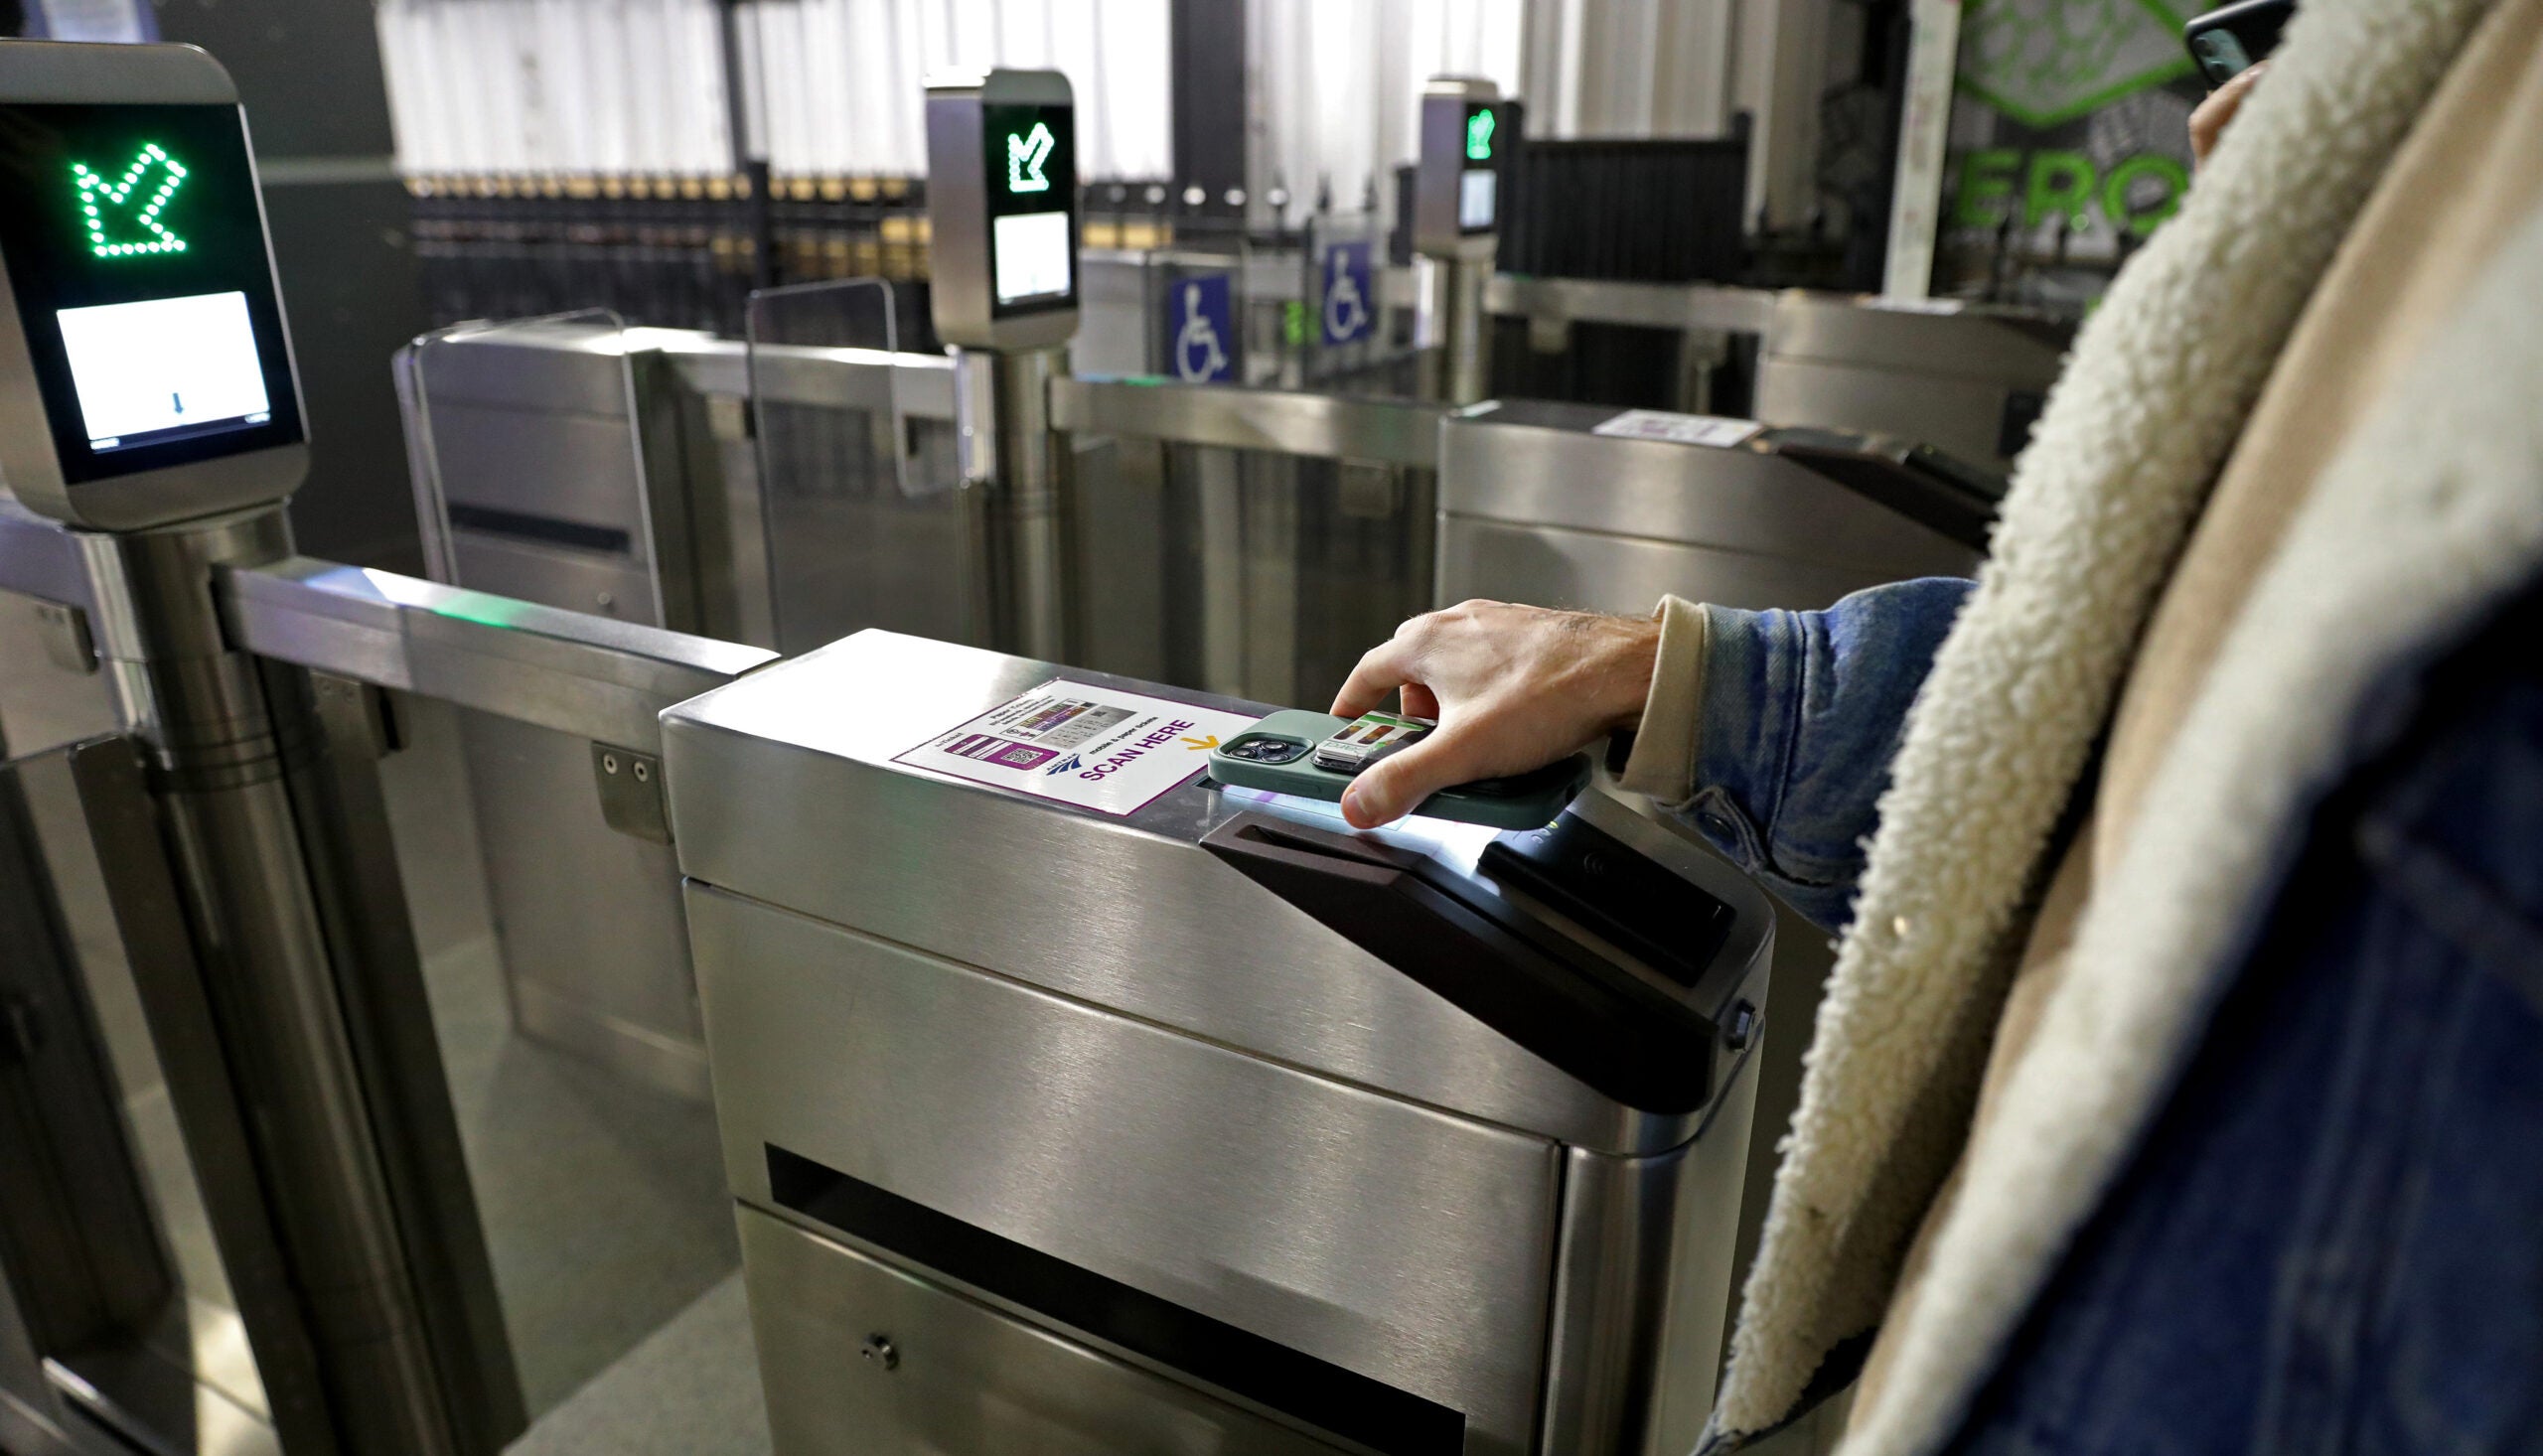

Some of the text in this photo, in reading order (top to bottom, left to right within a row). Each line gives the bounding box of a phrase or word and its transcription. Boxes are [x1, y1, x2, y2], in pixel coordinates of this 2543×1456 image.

[1080, 749, 1144, 781] SCAN
[1134, 720, 1195, 749] HERE
[1090, 742, 1113, 754] mobile
[1118, 728, 1136, 739] paper
[1135, 716, 1158, 728] tickets
[1047, 753, 1078, 771] AMTRAK
